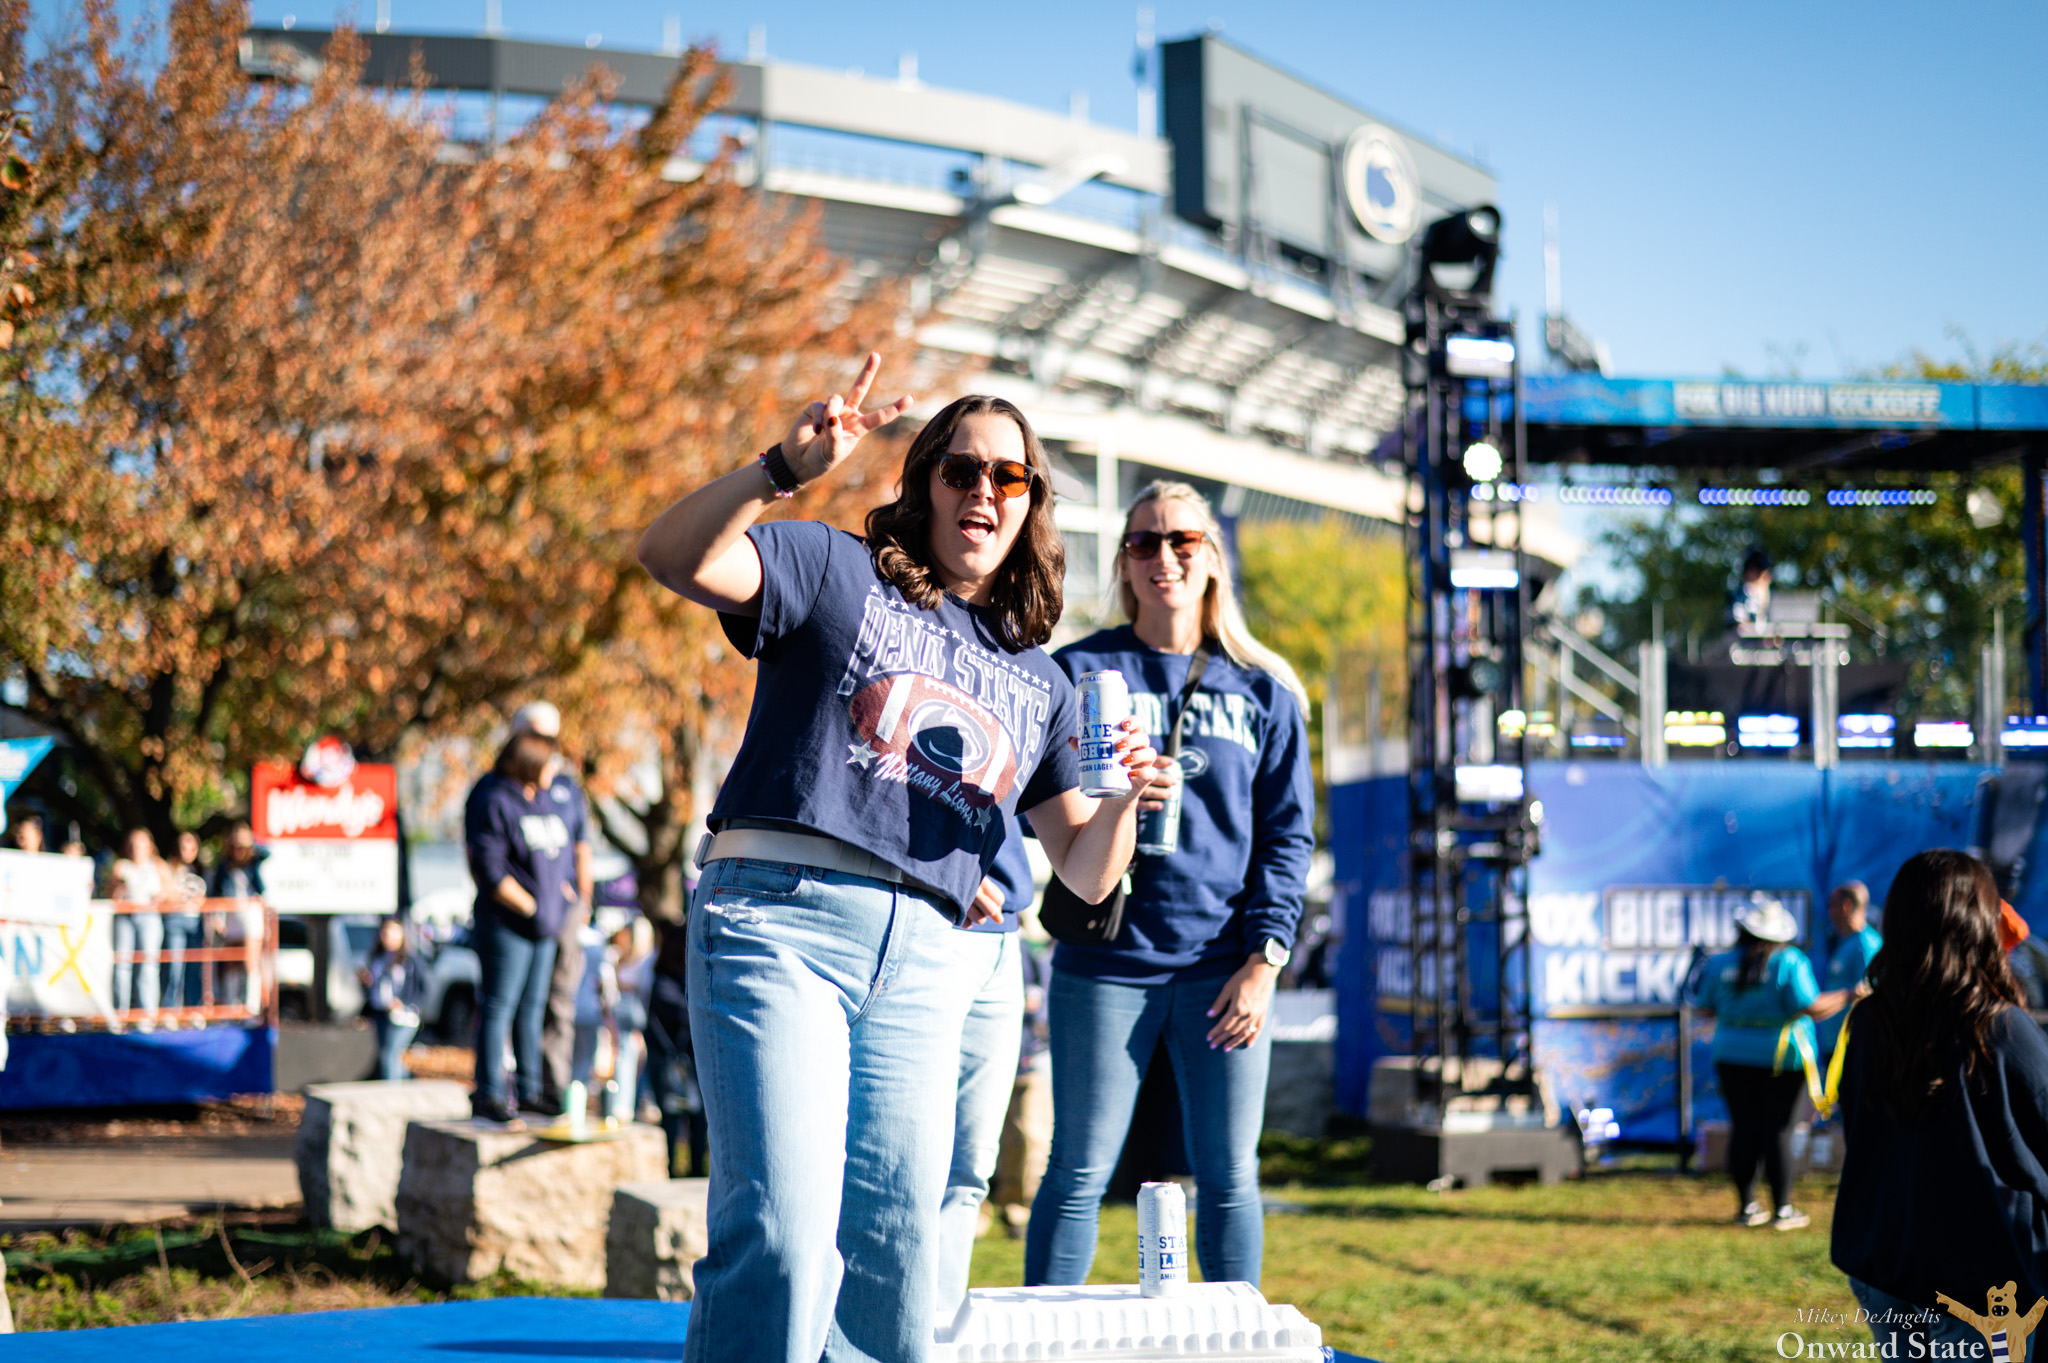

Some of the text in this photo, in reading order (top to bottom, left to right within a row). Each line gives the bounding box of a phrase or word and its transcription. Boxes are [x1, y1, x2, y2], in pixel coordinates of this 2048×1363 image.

[837, 594, 1051, 792] PENN STATE
[1079, 723, 1112, 740] ATE
[1079, 742, 1113, 760] GHT
[1094, 763, 1113, 771] LAGER
[873, 751, 975, 827] Nittany Lions
[1610, 889, 1685, 949] BIG
